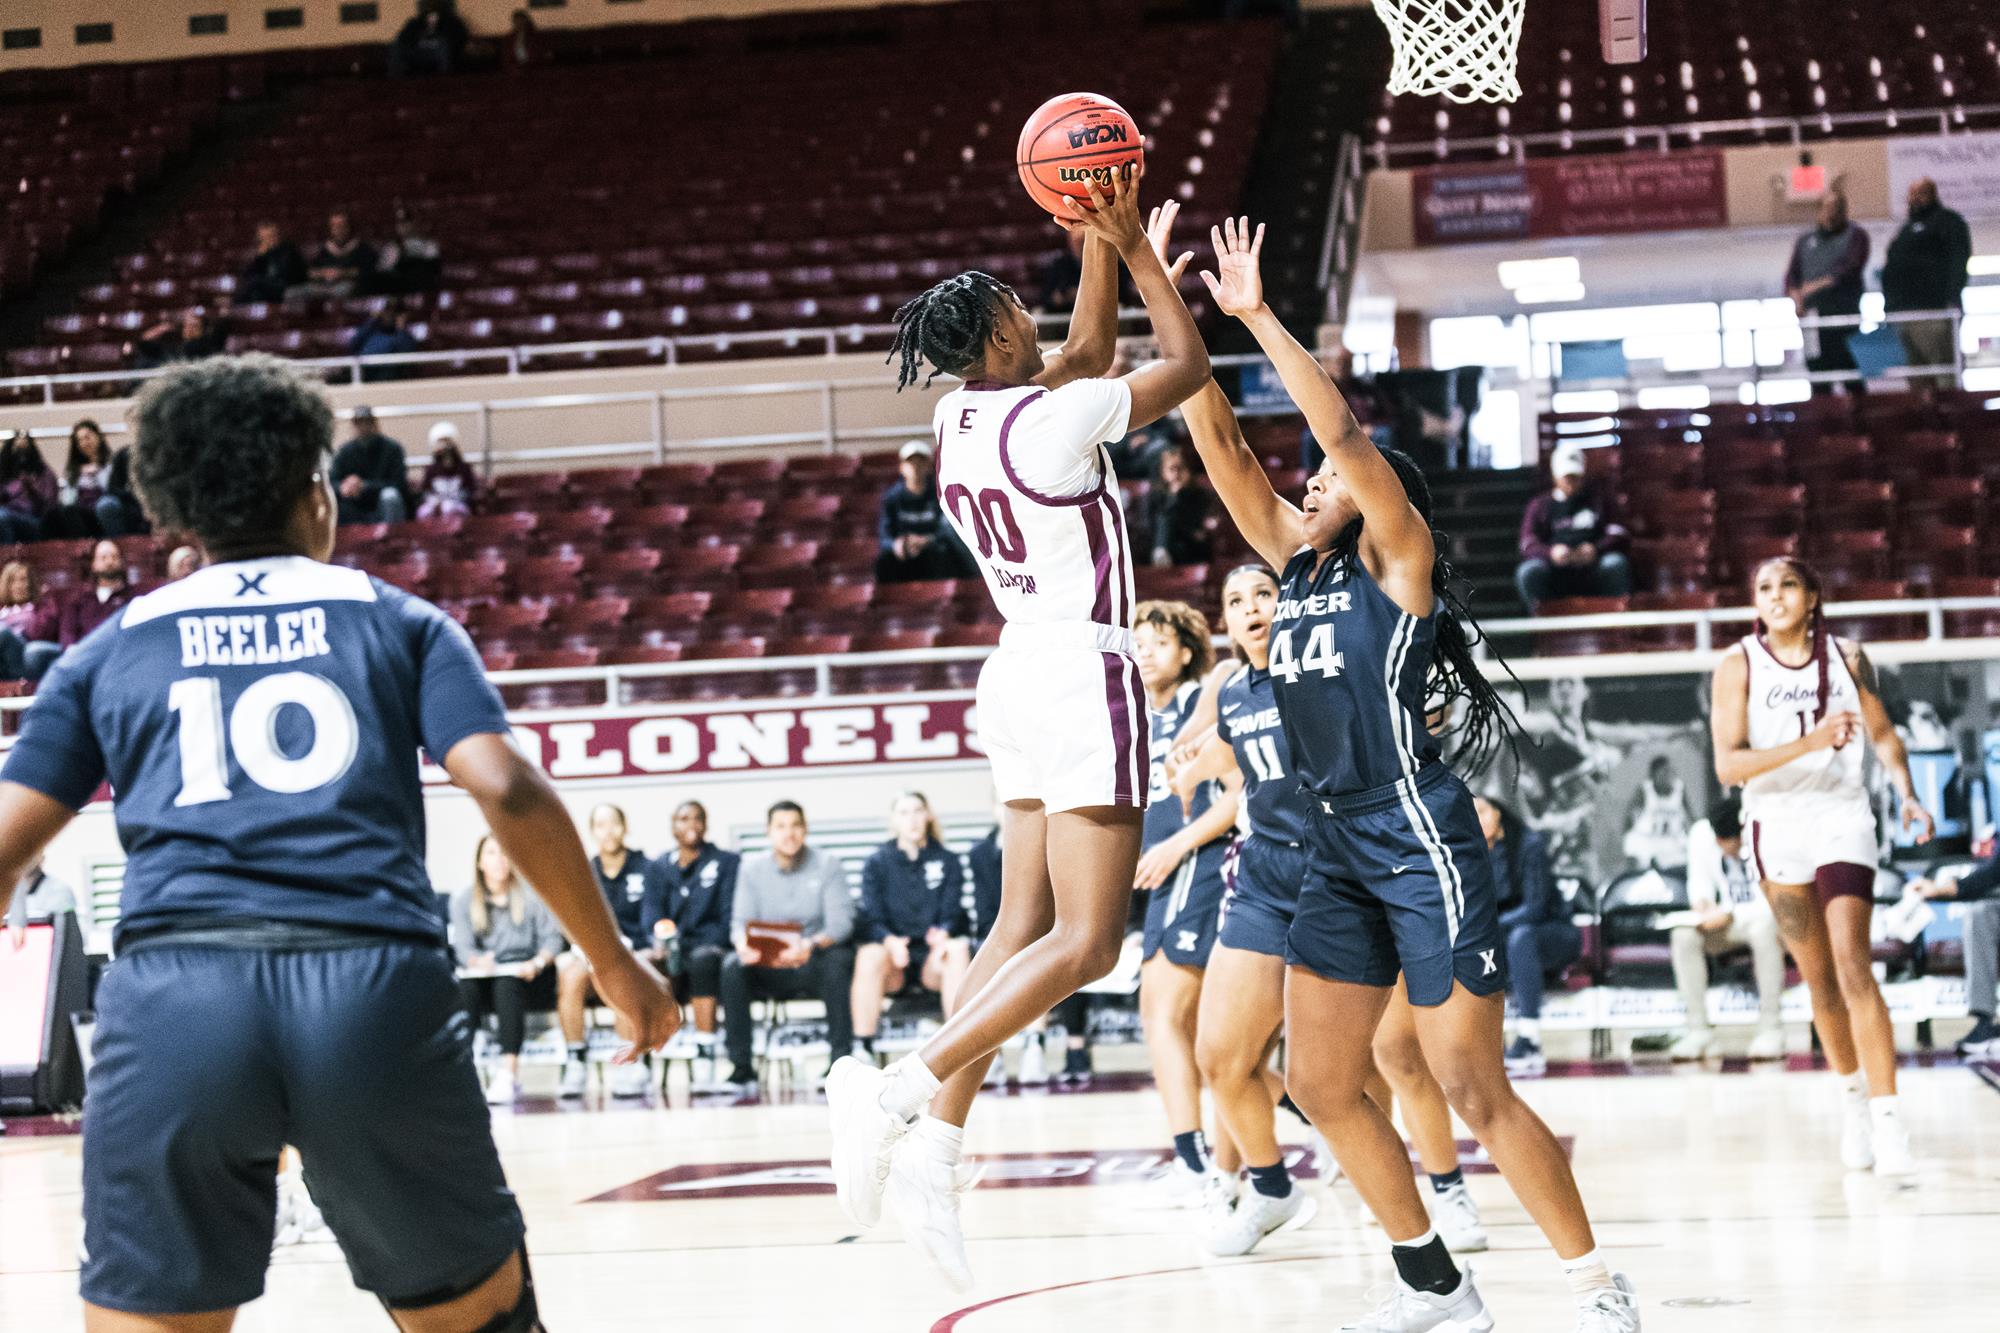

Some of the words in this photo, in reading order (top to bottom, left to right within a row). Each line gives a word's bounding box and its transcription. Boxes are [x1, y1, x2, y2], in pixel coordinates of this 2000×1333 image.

[1068, 124, 1127, 149] NCAA
[1059, 158, 1137, 187] Wlson
[944, 483, 1027, 563] 00
[235, 573, 270, 597] X
[177, 606, 330, 668] BEELER
[1269, 623, 1344, 684] 44
[168, 671, 359, 807] 10
[1226, 707, 1282, 737] XAVIE
[1244, 735, 1285, 782] 11
[1477, 948, 1498, 976] X
